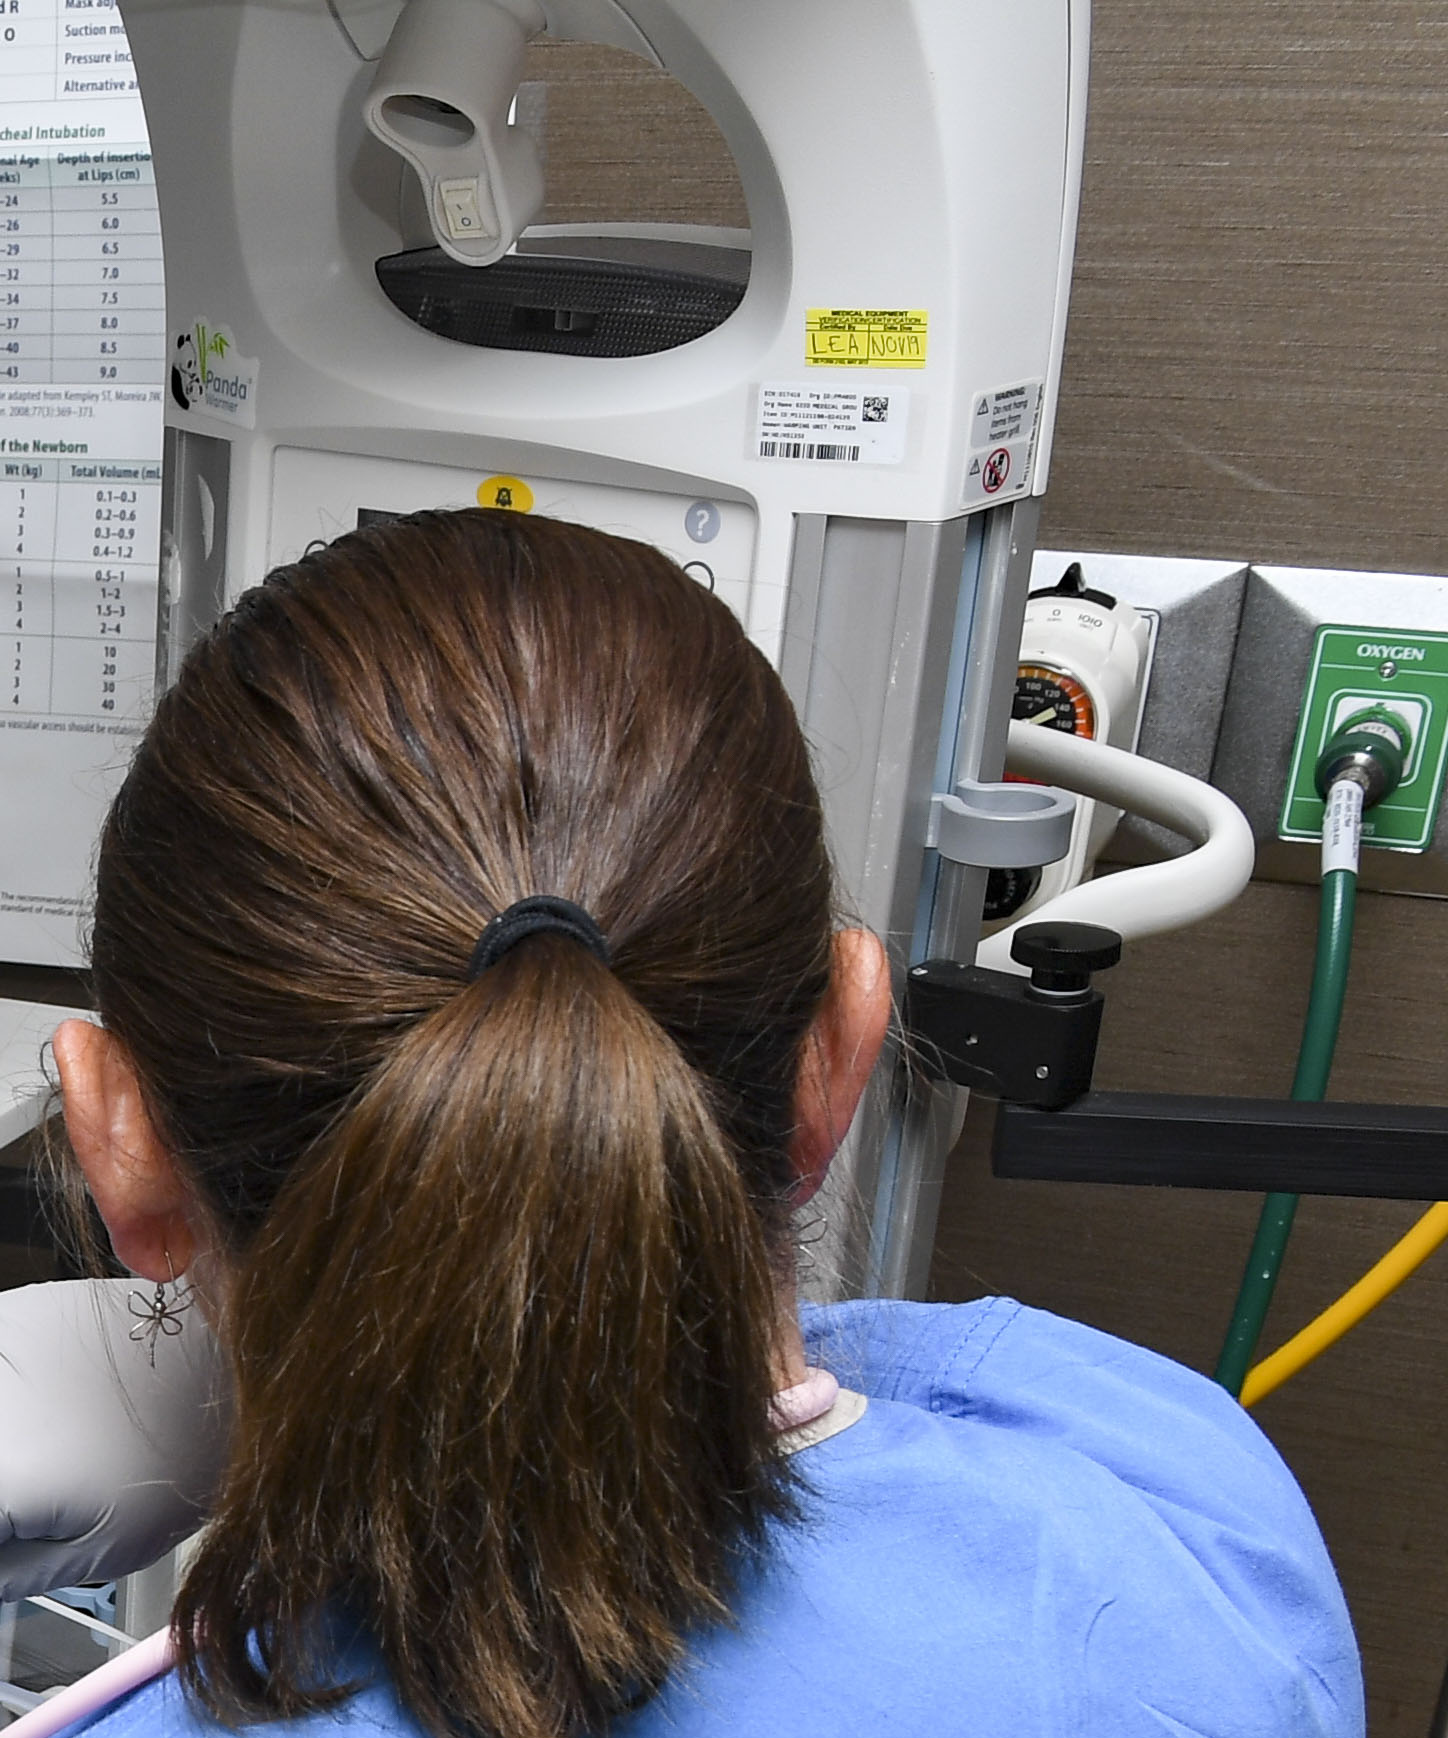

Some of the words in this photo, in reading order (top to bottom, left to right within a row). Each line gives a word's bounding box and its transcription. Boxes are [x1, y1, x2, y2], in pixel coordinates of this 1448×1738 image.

[64, 24, 106, 37] Suction
[64, 52, 111, 64] Pressure
[64, 79, 124, 92] Alternative
[36, 125, 105, 139] Intubation
[20, 156, 39, 168] Age
[91, 168, 113, 181] Lips
[116, 168, 140, 181] (cm)
[101, 193, 118, 204] 5.5
[102, 218, 119, 229] 6.0
[102, 242, 119, 254] 6.5
[101, 317, 118, 328] 8.0
[101, 342, 117, 353] 8.5
[100, 367, 117, 378] 9.0
[206, 370, 247, 399] Panda
[8, 440, 29, 452] the
[33, 440, 88, 454] Newborn
[72, 465, 97, 478] Total
[100, 466, 139, 479] Volume
[1356, 643, 1426, 662] OXYGEN
[1045, 690, 1060, 698] 120
